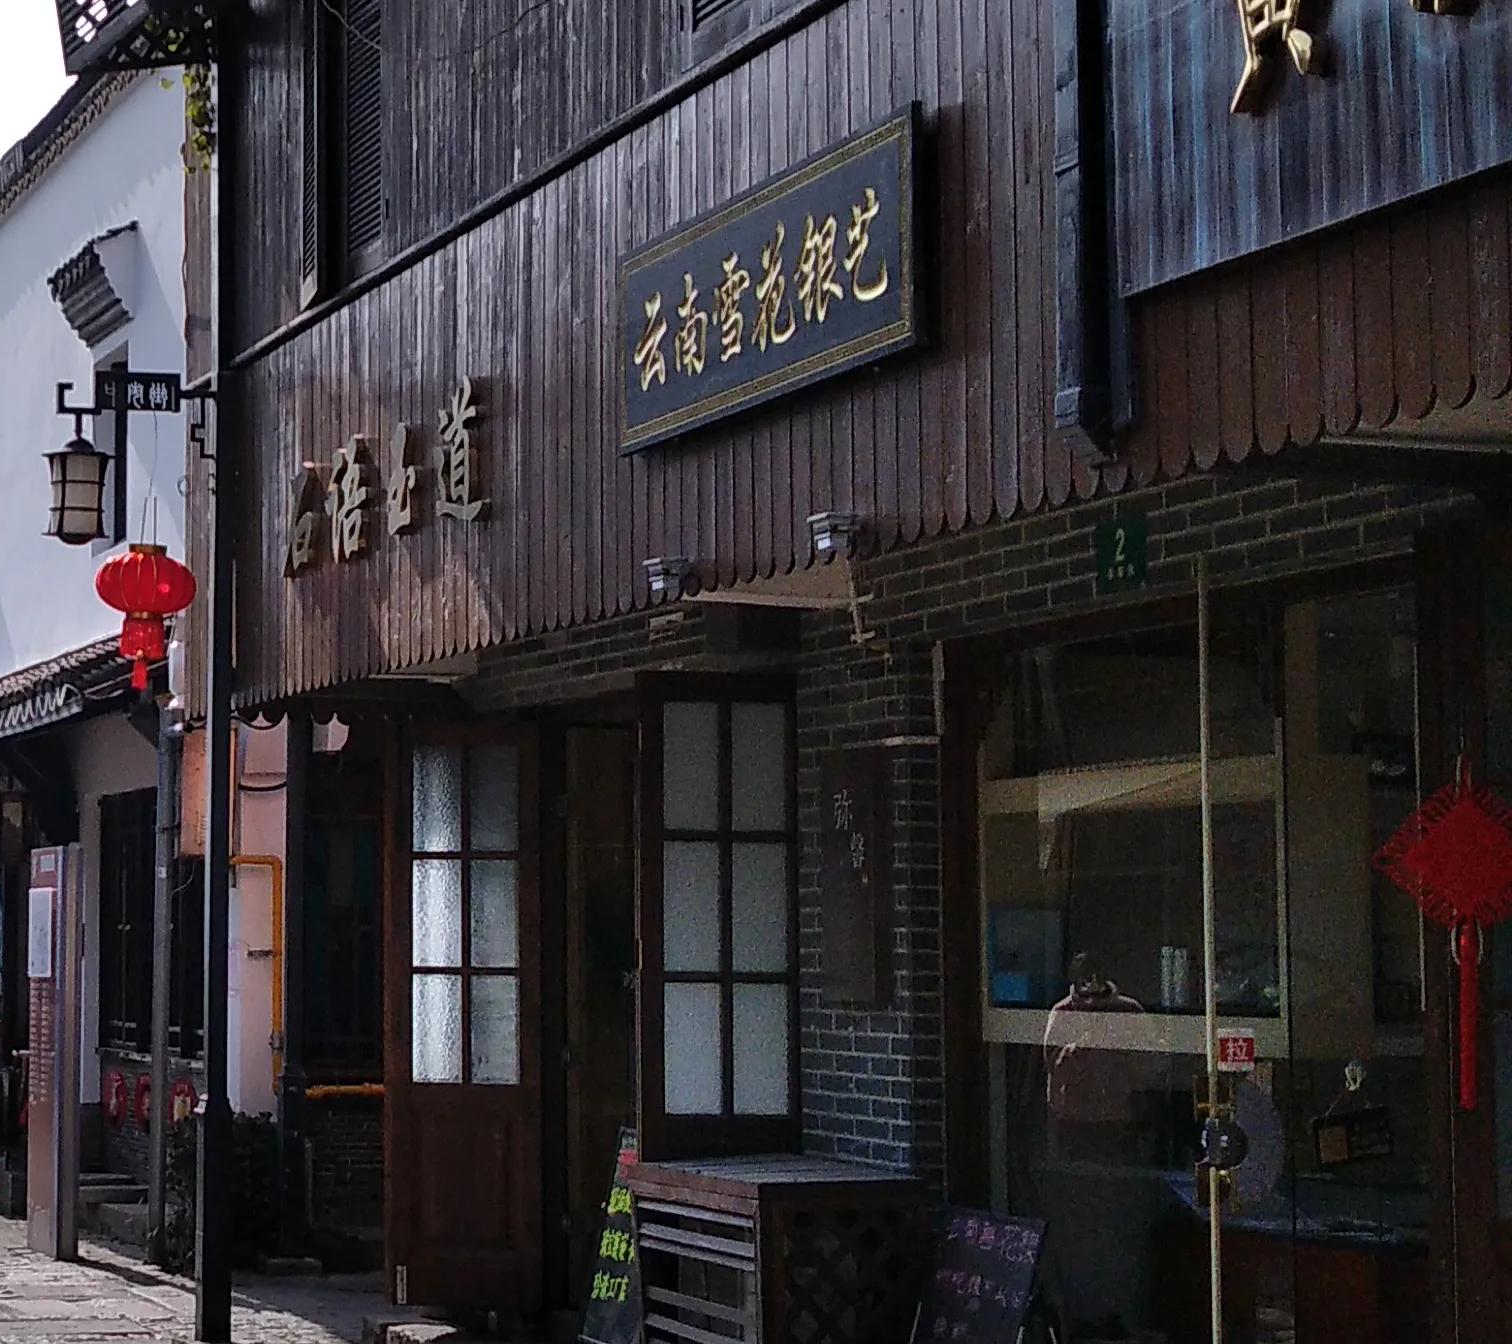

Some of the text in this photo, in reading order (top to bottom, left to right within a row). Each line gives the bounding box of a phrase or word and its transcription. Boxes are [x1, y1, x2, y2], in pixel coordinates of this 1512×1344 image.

[634, 186, 890, 393] 云南雪花银艺
[1114, 527, 1126, 562] 2
[1226, 1037, 1250, 1063] 拉
